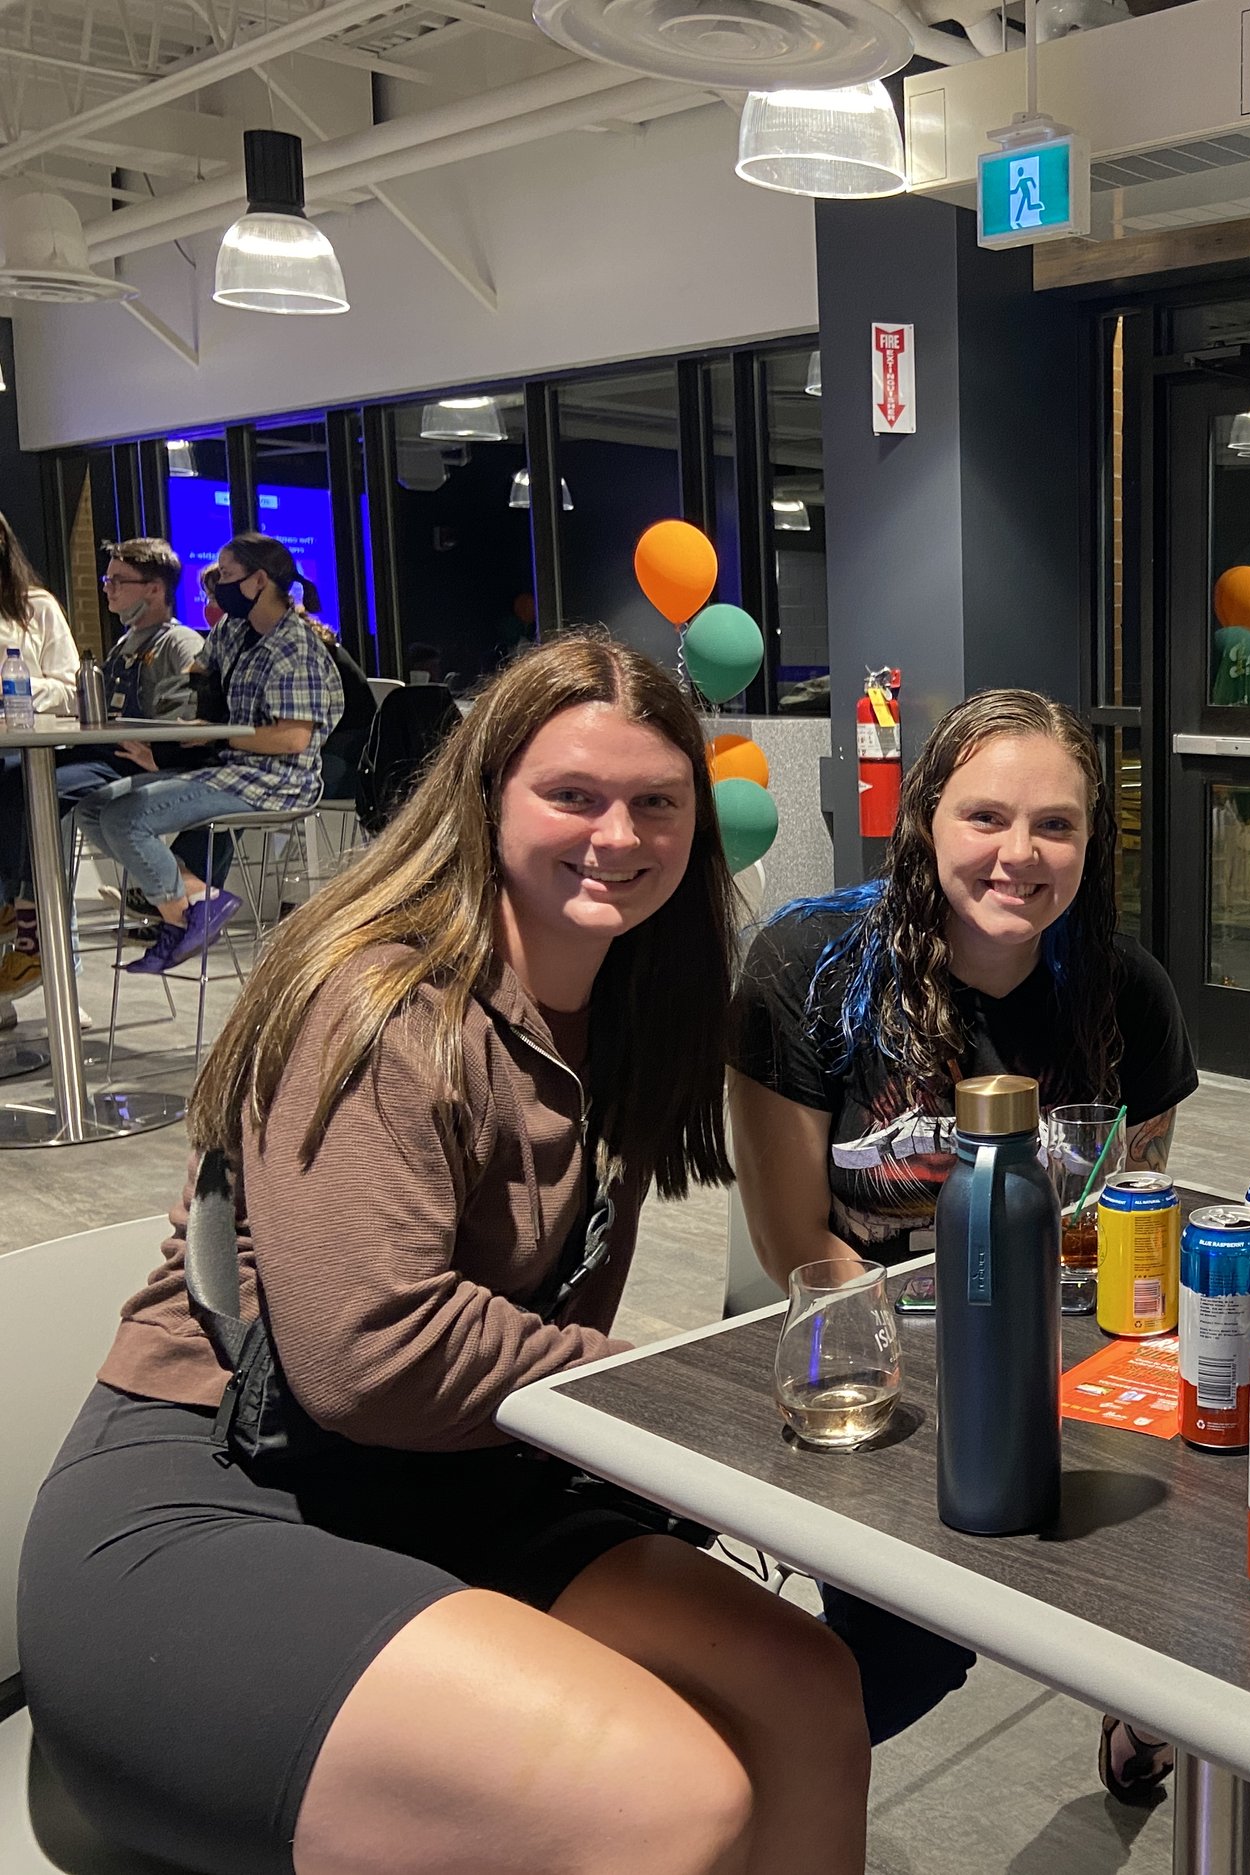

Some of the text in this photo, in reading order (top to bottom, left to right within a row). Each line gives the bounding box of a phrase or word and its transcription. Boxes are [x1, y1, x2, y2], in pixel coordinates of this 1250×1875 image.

[880, 334, 900, 349] FIRE
[886, 350, 896, 421] EXTINGUISHER
[1199, 1239, 1212, 1247] BLUE
[1212, 1241, 1245, 1249] RASPBERRY
